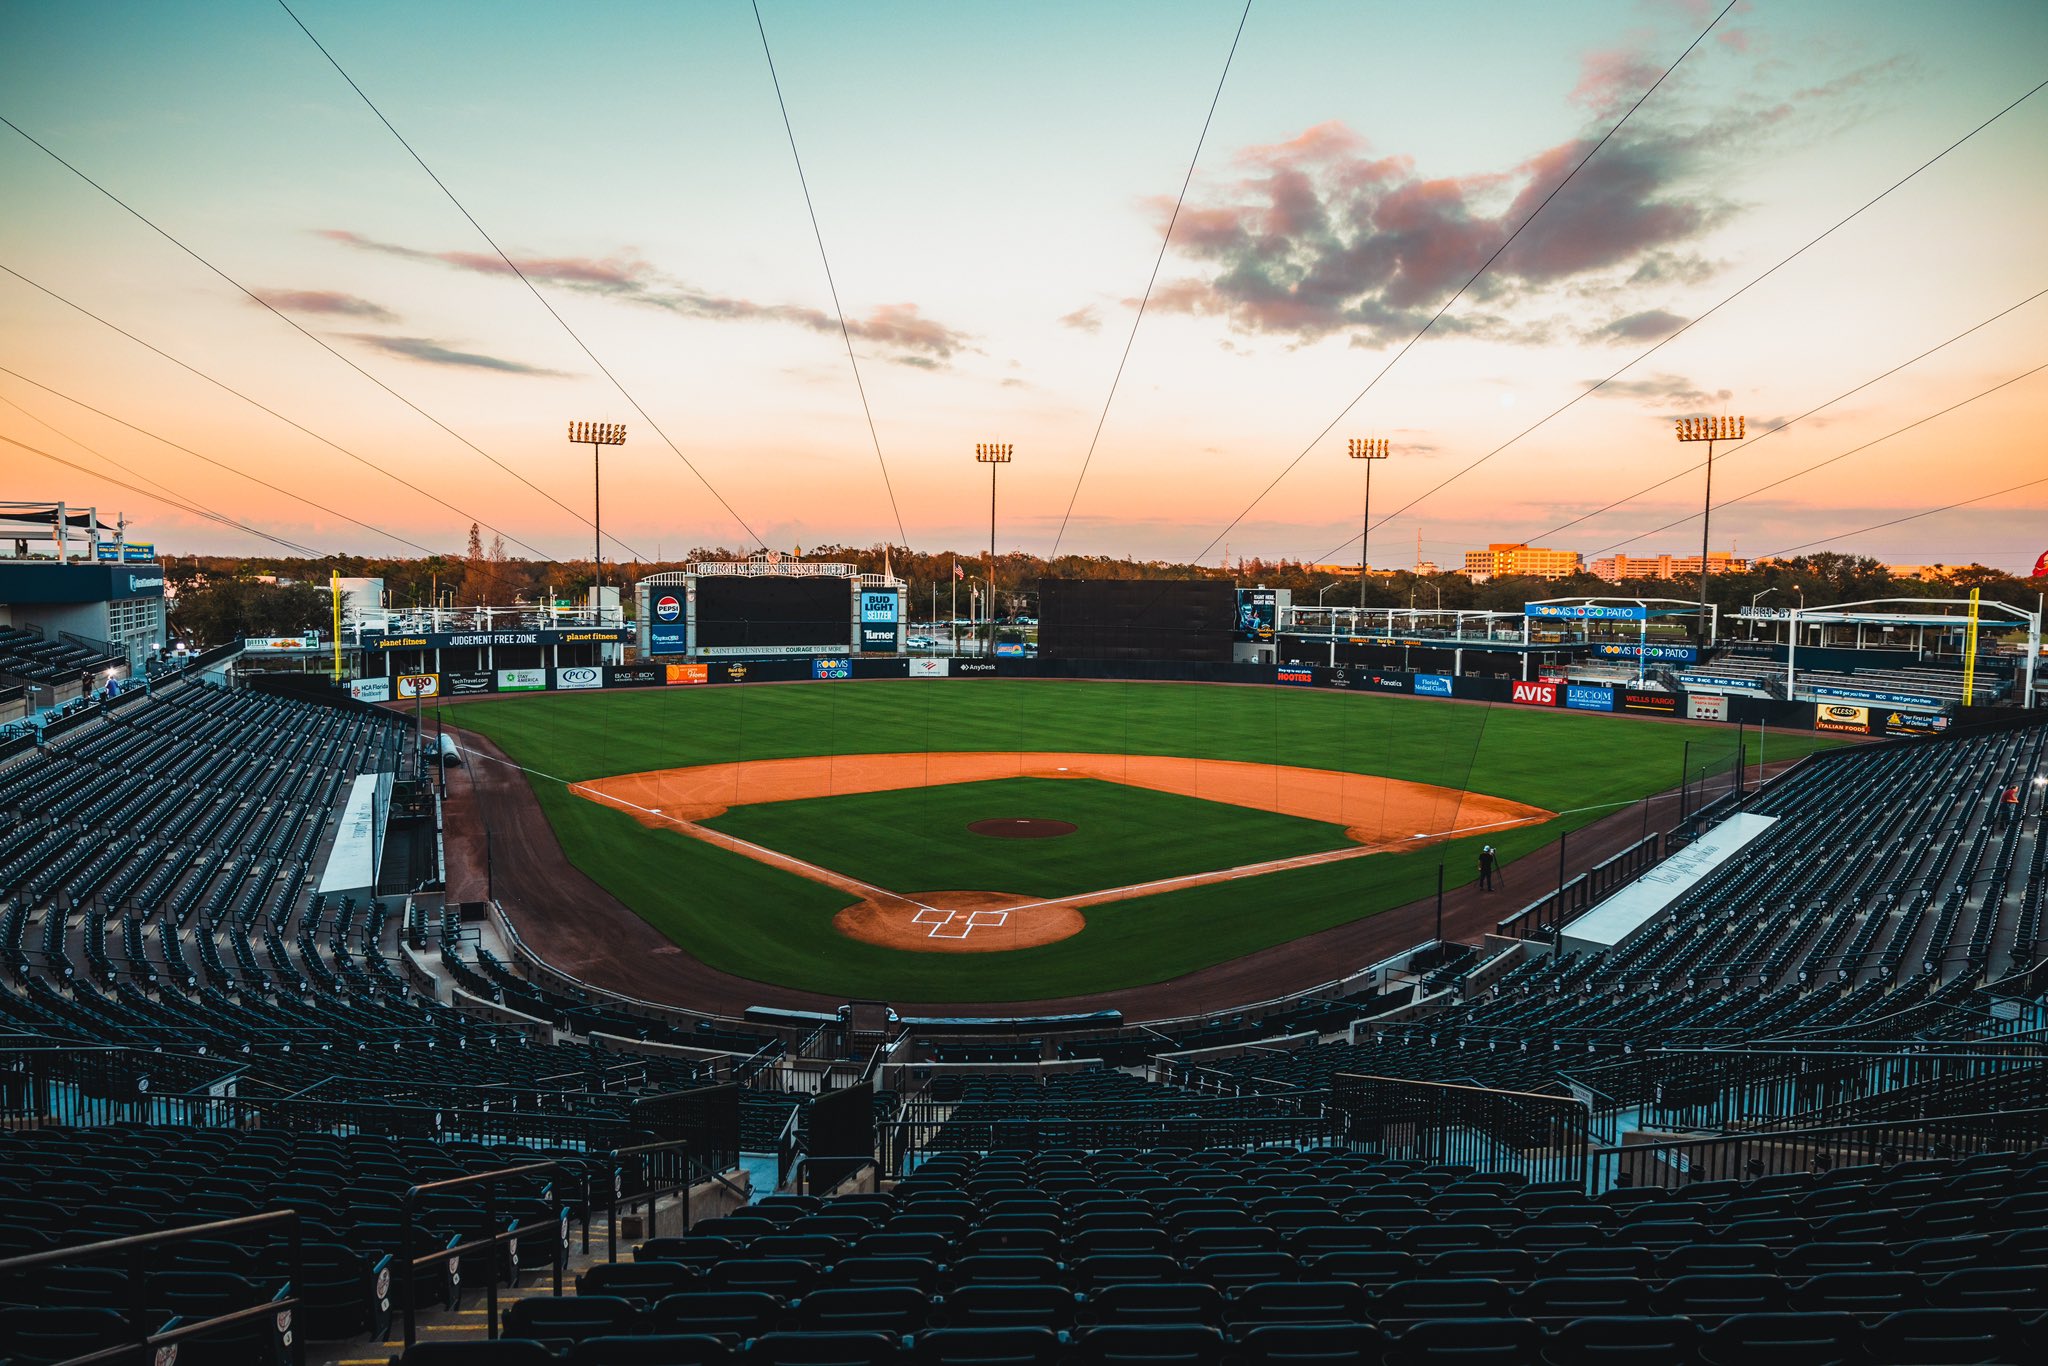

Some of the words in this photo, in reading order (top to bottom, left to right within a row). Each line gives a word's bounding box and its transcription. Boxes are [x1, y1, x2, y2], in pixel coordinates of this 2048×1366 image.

[698, 564, 737, 574] GEORGE
[751, 564, 819, 574] STEINBRENNER
[820, 565, 848, 574] FIELD
[869, 595, 890, 603] BUD
[864, 603, 894, 611] LIGHT
[1535, 606, 1571, 616] ROOMS
[1573, 608, 1585, 616] TO
[1587, 608, 1603, 617] GO
[1606, 608, 1633, 617] PATIO
[867, 611, 892, 620] SELTZER
[449, 635, 493, 646] JUDGEMENT
[494, 634, 514, 645] FREE
[515, 633, 537, 644] ZONE
[566, 633, 592, 642] planet
[592, 631, 618, 640] fitness
[863, 630, 895, 640] Turner
[379, 639, 402, 649] planet
[402, 637, 427, 646] fitness
[745, 647, 783, 655] UNIVERSITY
[1600, 645, 1631, 655] ROOMS
[1632, 647, 1643, 656] TO
[1643, 647, 1659, 656] GO
[1665, 649, 1689, 658] PATIO
[816, 660, 849, 668] ROOMS
[568, 670, 591, 680] PCC
[817, 670, 828, 679] TO
[829, 670, 844, 679] GO
[1277, 672, 1312, 683] HOOTERS
[1380, 678, 1402, 687] Fanatics
[1513, 685, 1552, 703] AVIS
[1568, 689, 1611, 700] LECOM
[1625, 695, 1650, 703] WELLS
[1650, 697, 1675, 705] FARGO
[1831, 707, 1855, 716] ALESSI
[1844, 725, 1866, 733] FOODS
